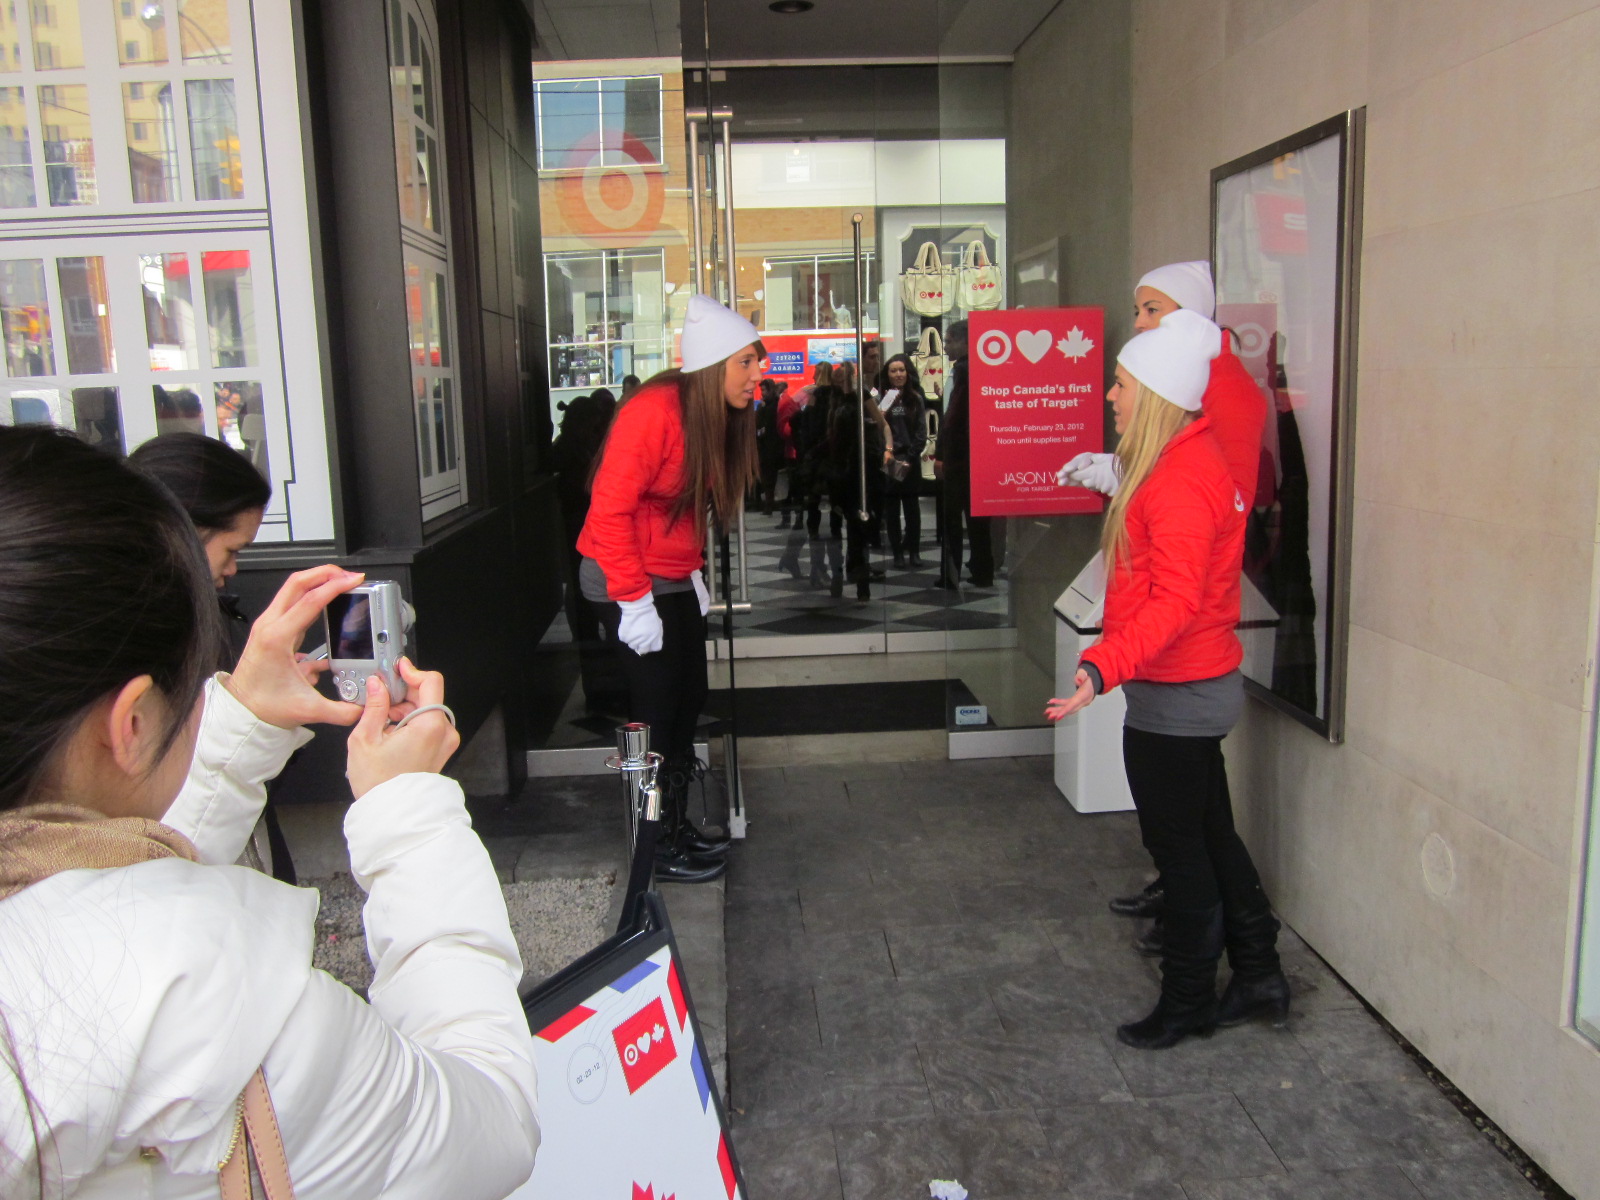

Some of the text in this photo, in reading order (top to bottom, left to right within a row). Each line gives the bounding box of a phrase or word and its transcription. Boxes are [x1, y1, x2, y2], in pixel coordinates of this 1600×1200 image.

[981, 383, 1092, 397] Shop Canada's first
[995, 398, 1079, 409] taste of Target
[989, 422, 1085, 433] Thursday, February 23, 2012
[997, 437, 1016, 445] Noon
[1033, 436, 1062, 444] supplies
[1062, 435, 1077, 443] last!
[998, 472, 1046, 486] JASON
